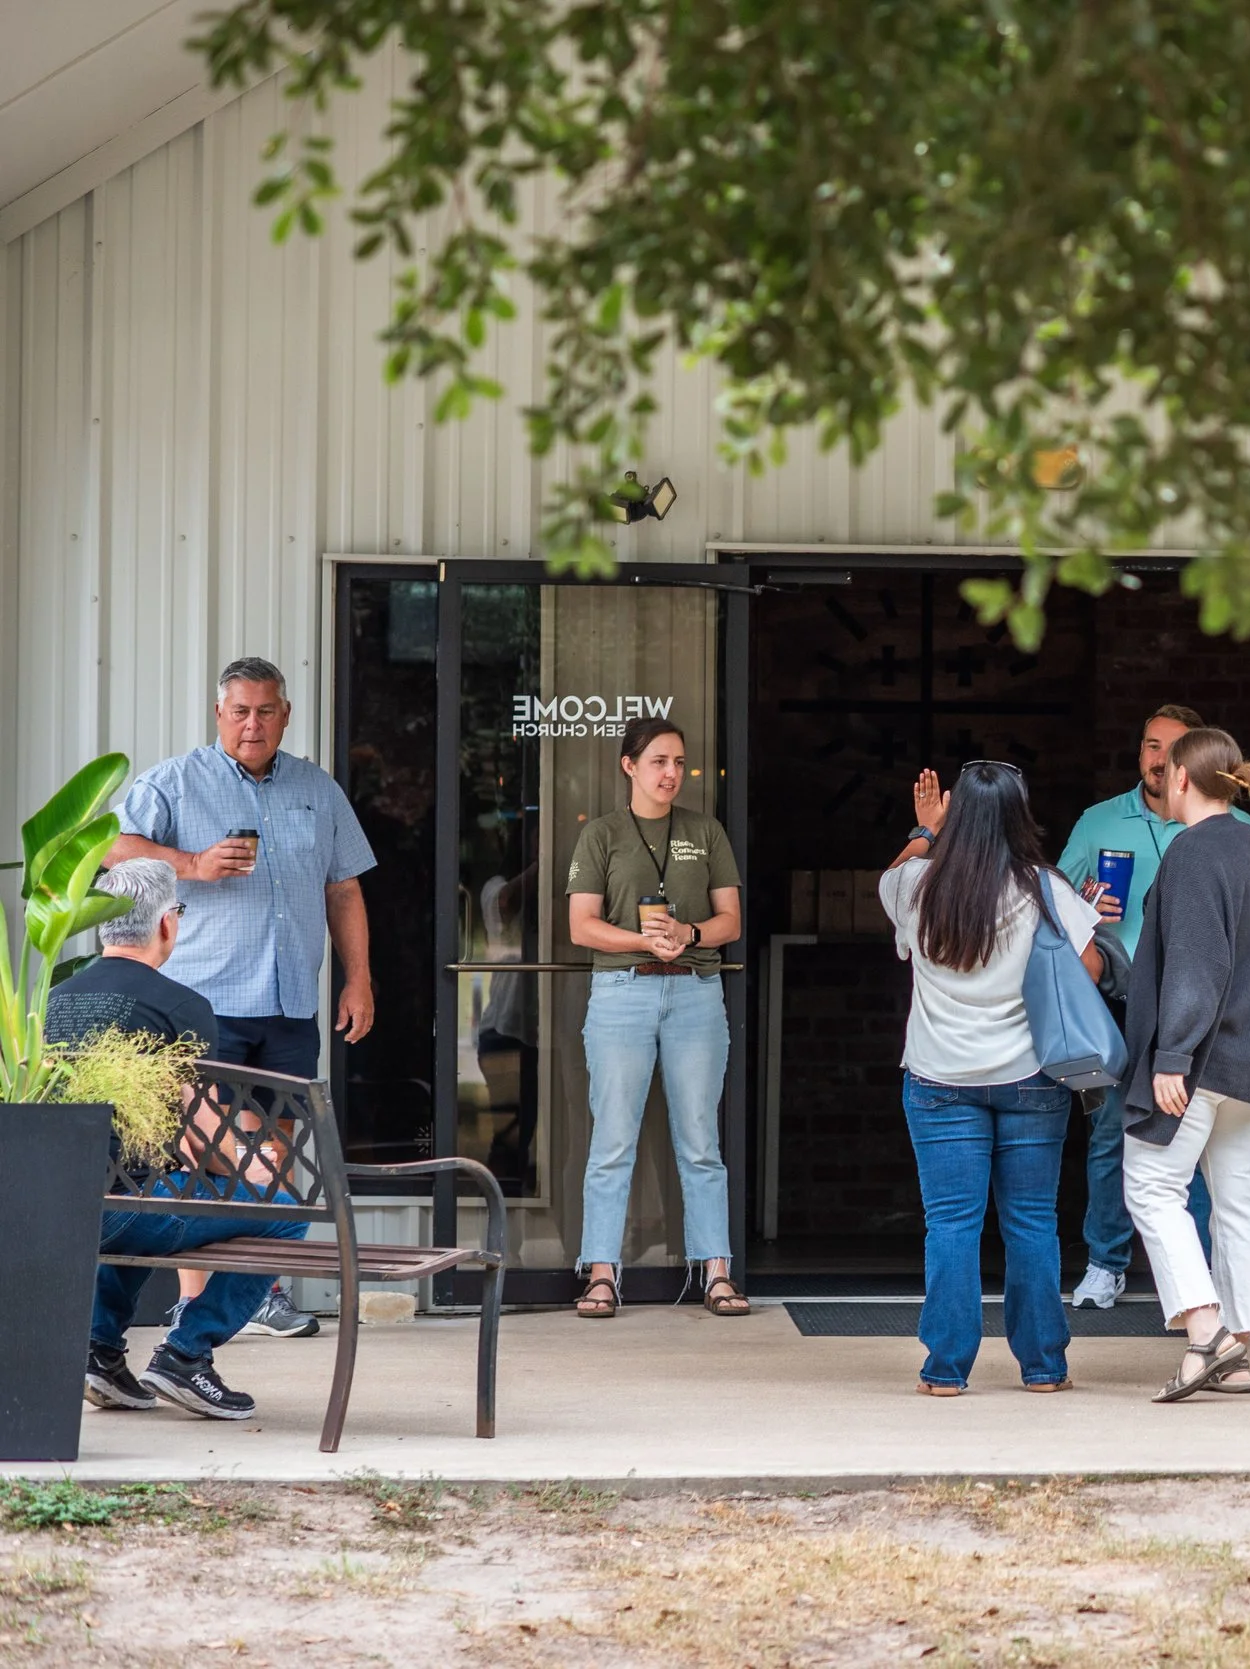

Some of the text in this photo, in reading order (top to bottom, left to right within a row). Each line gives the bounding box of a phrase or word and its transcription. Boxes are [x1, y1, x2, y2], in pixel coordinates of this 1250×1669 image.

[670, 839, 695, 848] Risen
[671, 847, 707, 856] Connect
[672, 853, 698, 861] Team
